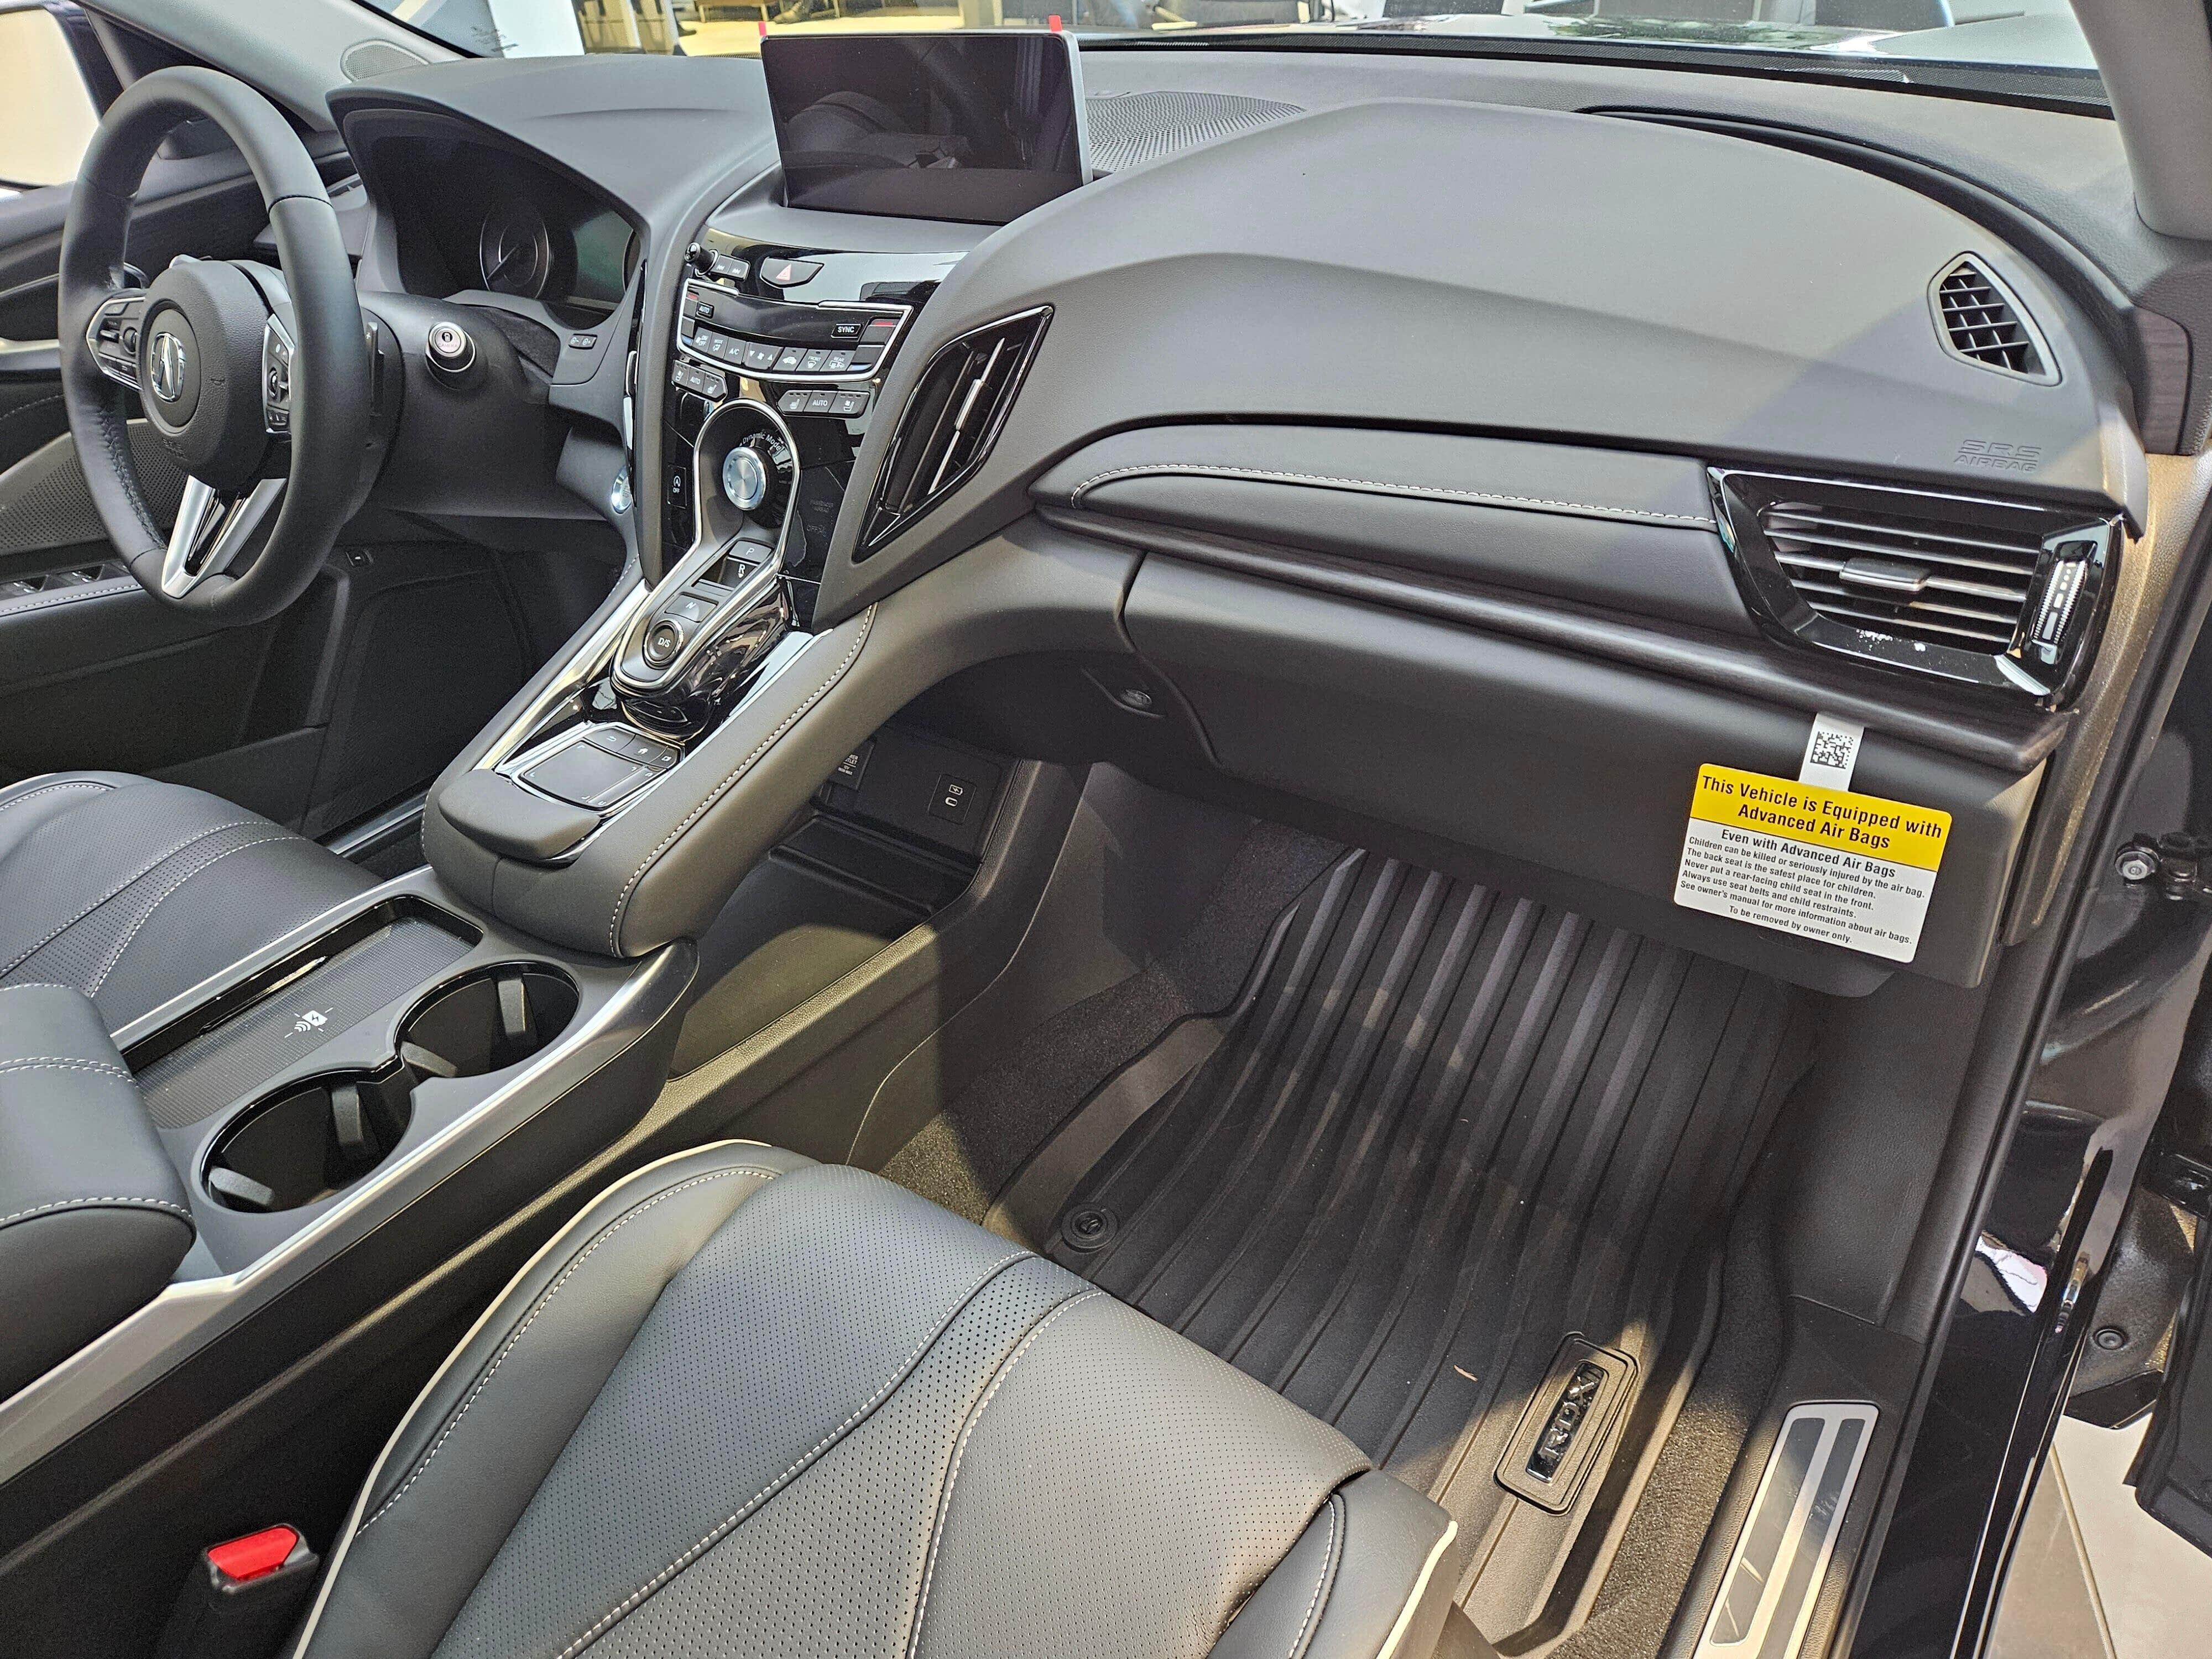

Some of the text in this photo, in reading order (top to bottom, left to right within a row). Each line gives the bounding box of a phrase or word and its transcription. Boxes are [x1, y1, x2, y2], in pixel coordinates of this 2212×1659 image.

[698, 305, 710, 314] AUTO
[690, 376, 701, 385] AUTO
[743, 432, 765, 444] Dynamic
[1961, 439, 2042, 457] SRS
[1954, 455, 2037, 471] AIRBAG
[738, 564, 746, 573] R
[658, 637, 671, 648] D/S
[1703, 775, 1942, 838] This Vehicle is Equipped with
[1738, 804, 1890, 849] Advanced Air Bags
[1687, 847, 1876, 899] The back seat is the safest place for children.
[1689, 836, 1723, 851] Children
[1724, 846, 1739, 854] can
[1741, 848, 1751, 857] be
[1753, 851, 1776, 863] killed
[1788, 860, 1828, 876] seriously
[1829, 868, 1860, 882] injured
[1862, 876, 1873, 886] by
[1875, 879, 1888, 889] the
[1891, 884, 1904, 892] air
[1905, 886, 1924, 898] bag.
[1721, 829, 1896, 878] Even with Advanced Air Bags
[1682, 870, 1856, 918] Always use seat belts and child restraints.
[1684, 858, 1708, 870] Never
[1710, 866, 1724, 874] put
[1733, 871, 1778, 889] rear-facing
[1780, 882, 1802, 893] child
[1803, 888, 1822, 898] seat
[1824, 891, 1832, 900] in
[1835, 894, 1848, 904] the
[1851, 898, 1874, 910] front.
[1681, 880, 1695, 890] See
[1730, 894, 1760, 906] manual
[1762, 900, 1773, 909] for
[1775, 905, 1796, 915] more
[1798, 909, 1846, 927] information
[1848, 922, 1872, 934] about
[1874, 929, 1887, 937] air
[1888, 931, 1912, 944] bags.
[1729, 905, 1851, 943] To be removed by owner only.
[1537, 1376, 1595, 1460] RDX
